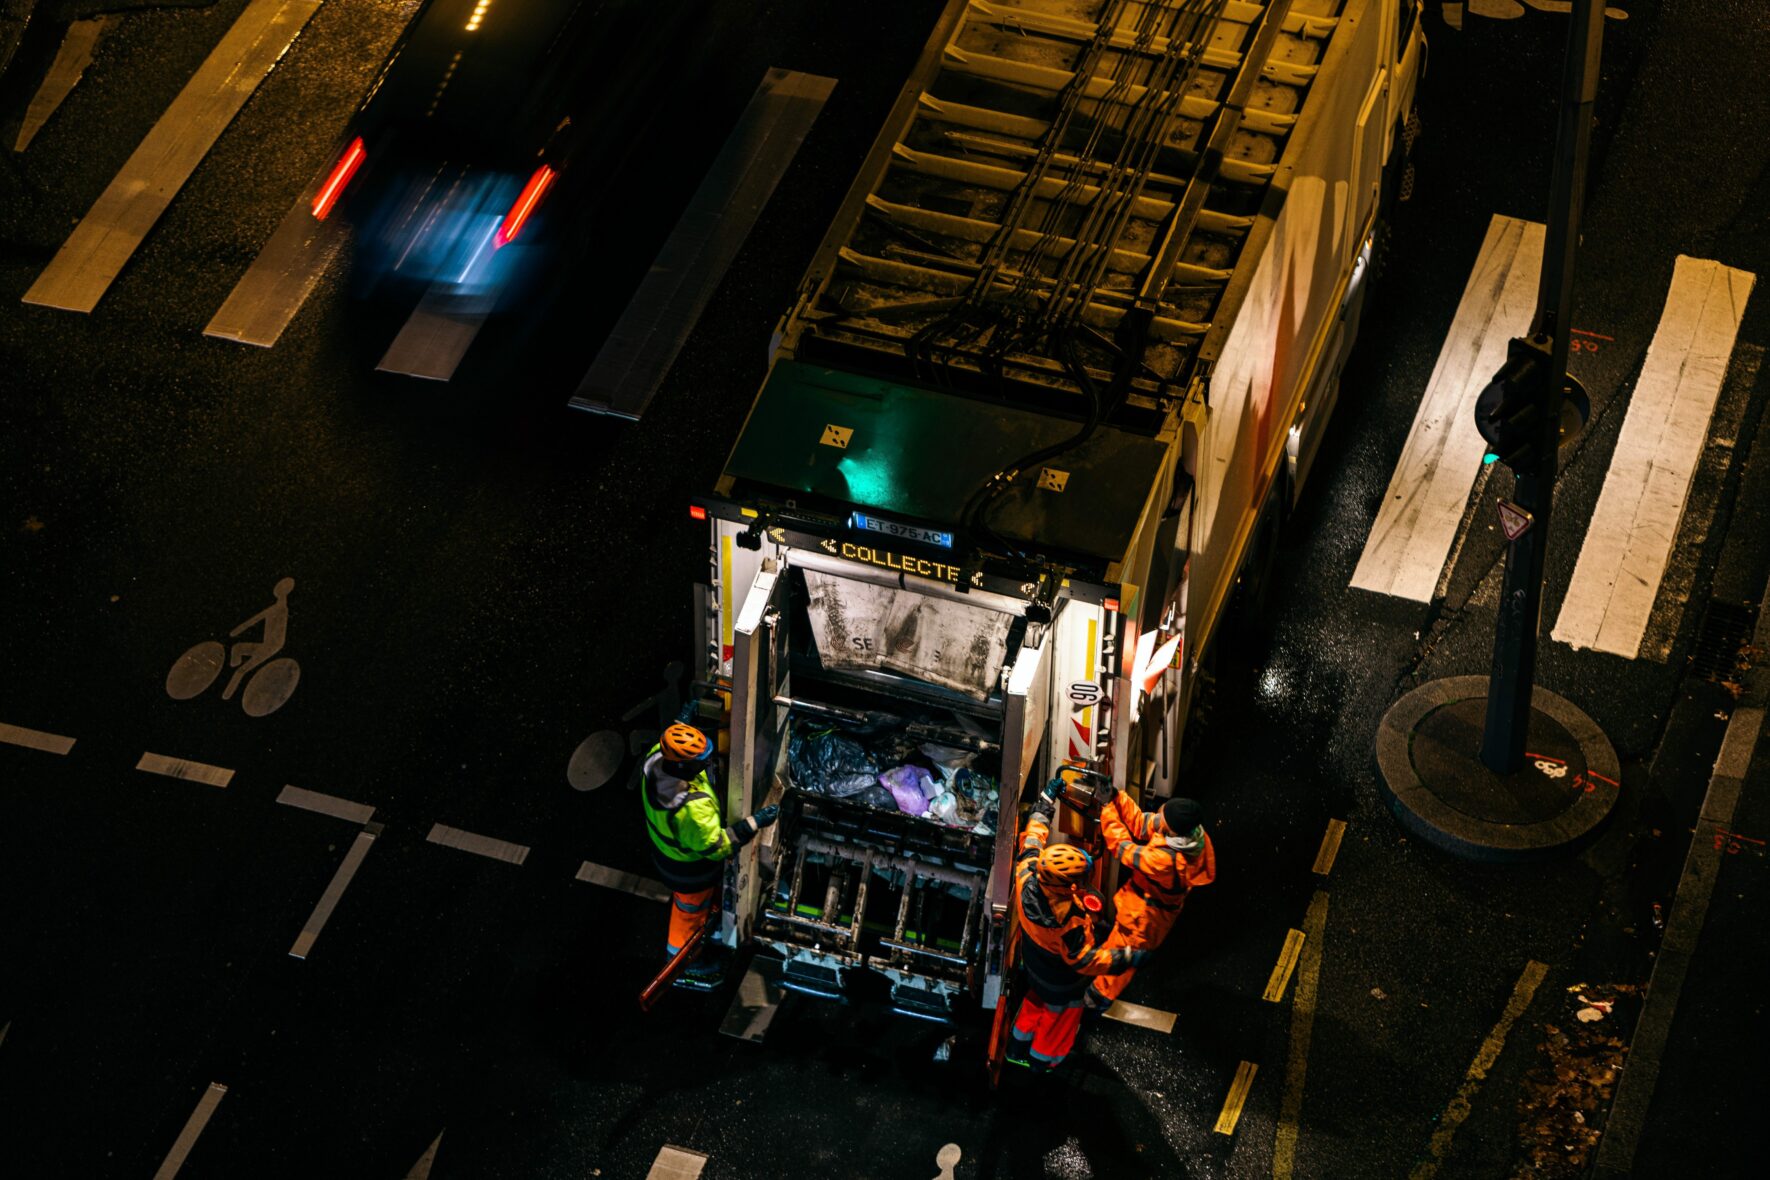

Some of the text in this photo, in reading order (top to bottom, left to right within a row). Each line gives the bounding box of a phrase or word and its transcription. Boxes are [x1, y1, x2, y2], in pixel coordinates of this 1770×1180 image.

[866, 518, 941, 544] ET-975-AC
[842, 542, 960, 582] COLLECTE
[1070, 683, 1099, 702] 90
